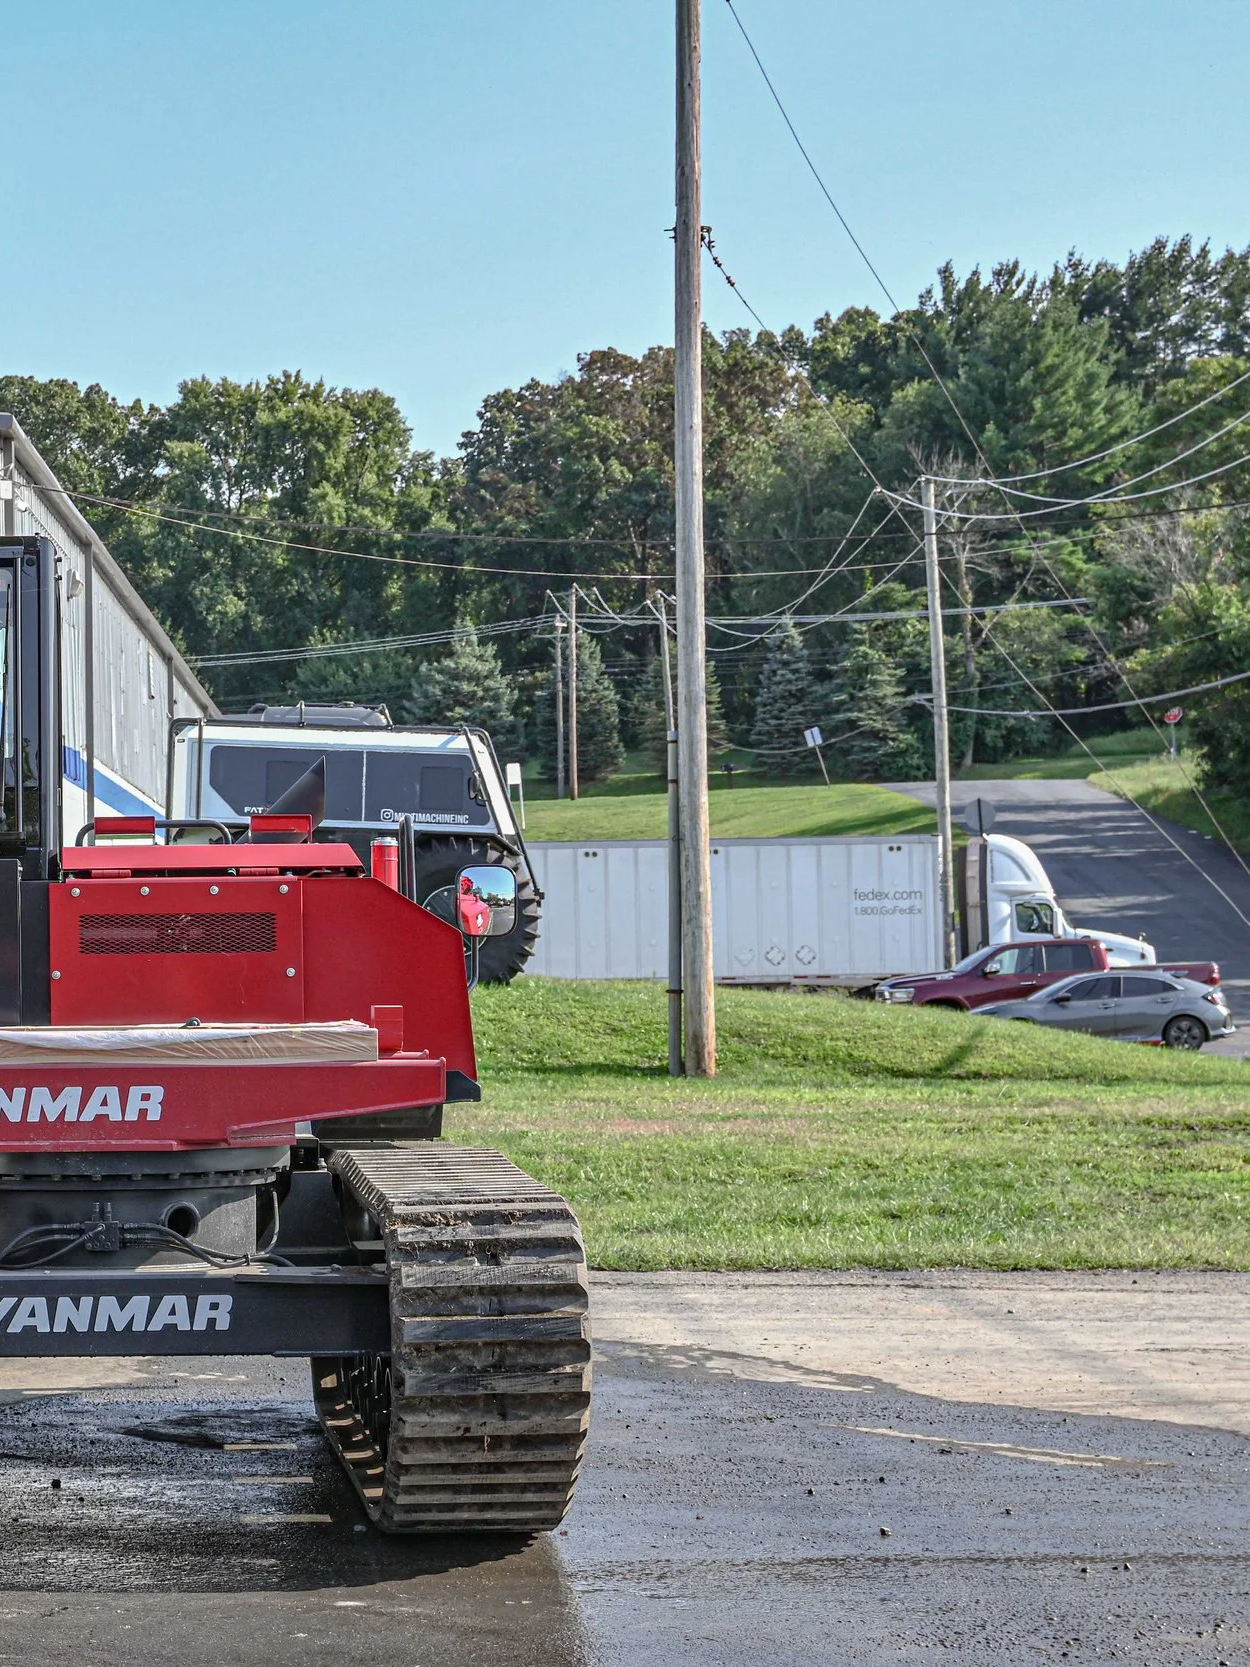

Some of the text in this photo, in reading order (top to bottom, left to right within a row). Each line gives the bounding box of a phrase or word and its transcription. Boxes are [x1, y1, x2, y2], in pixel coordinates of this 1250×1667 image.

[244, 806, 264, 814] FAT
[394, 812, 469, 824] MTIMACHINEINC
[853, 888, 923, 901] fedex.com
